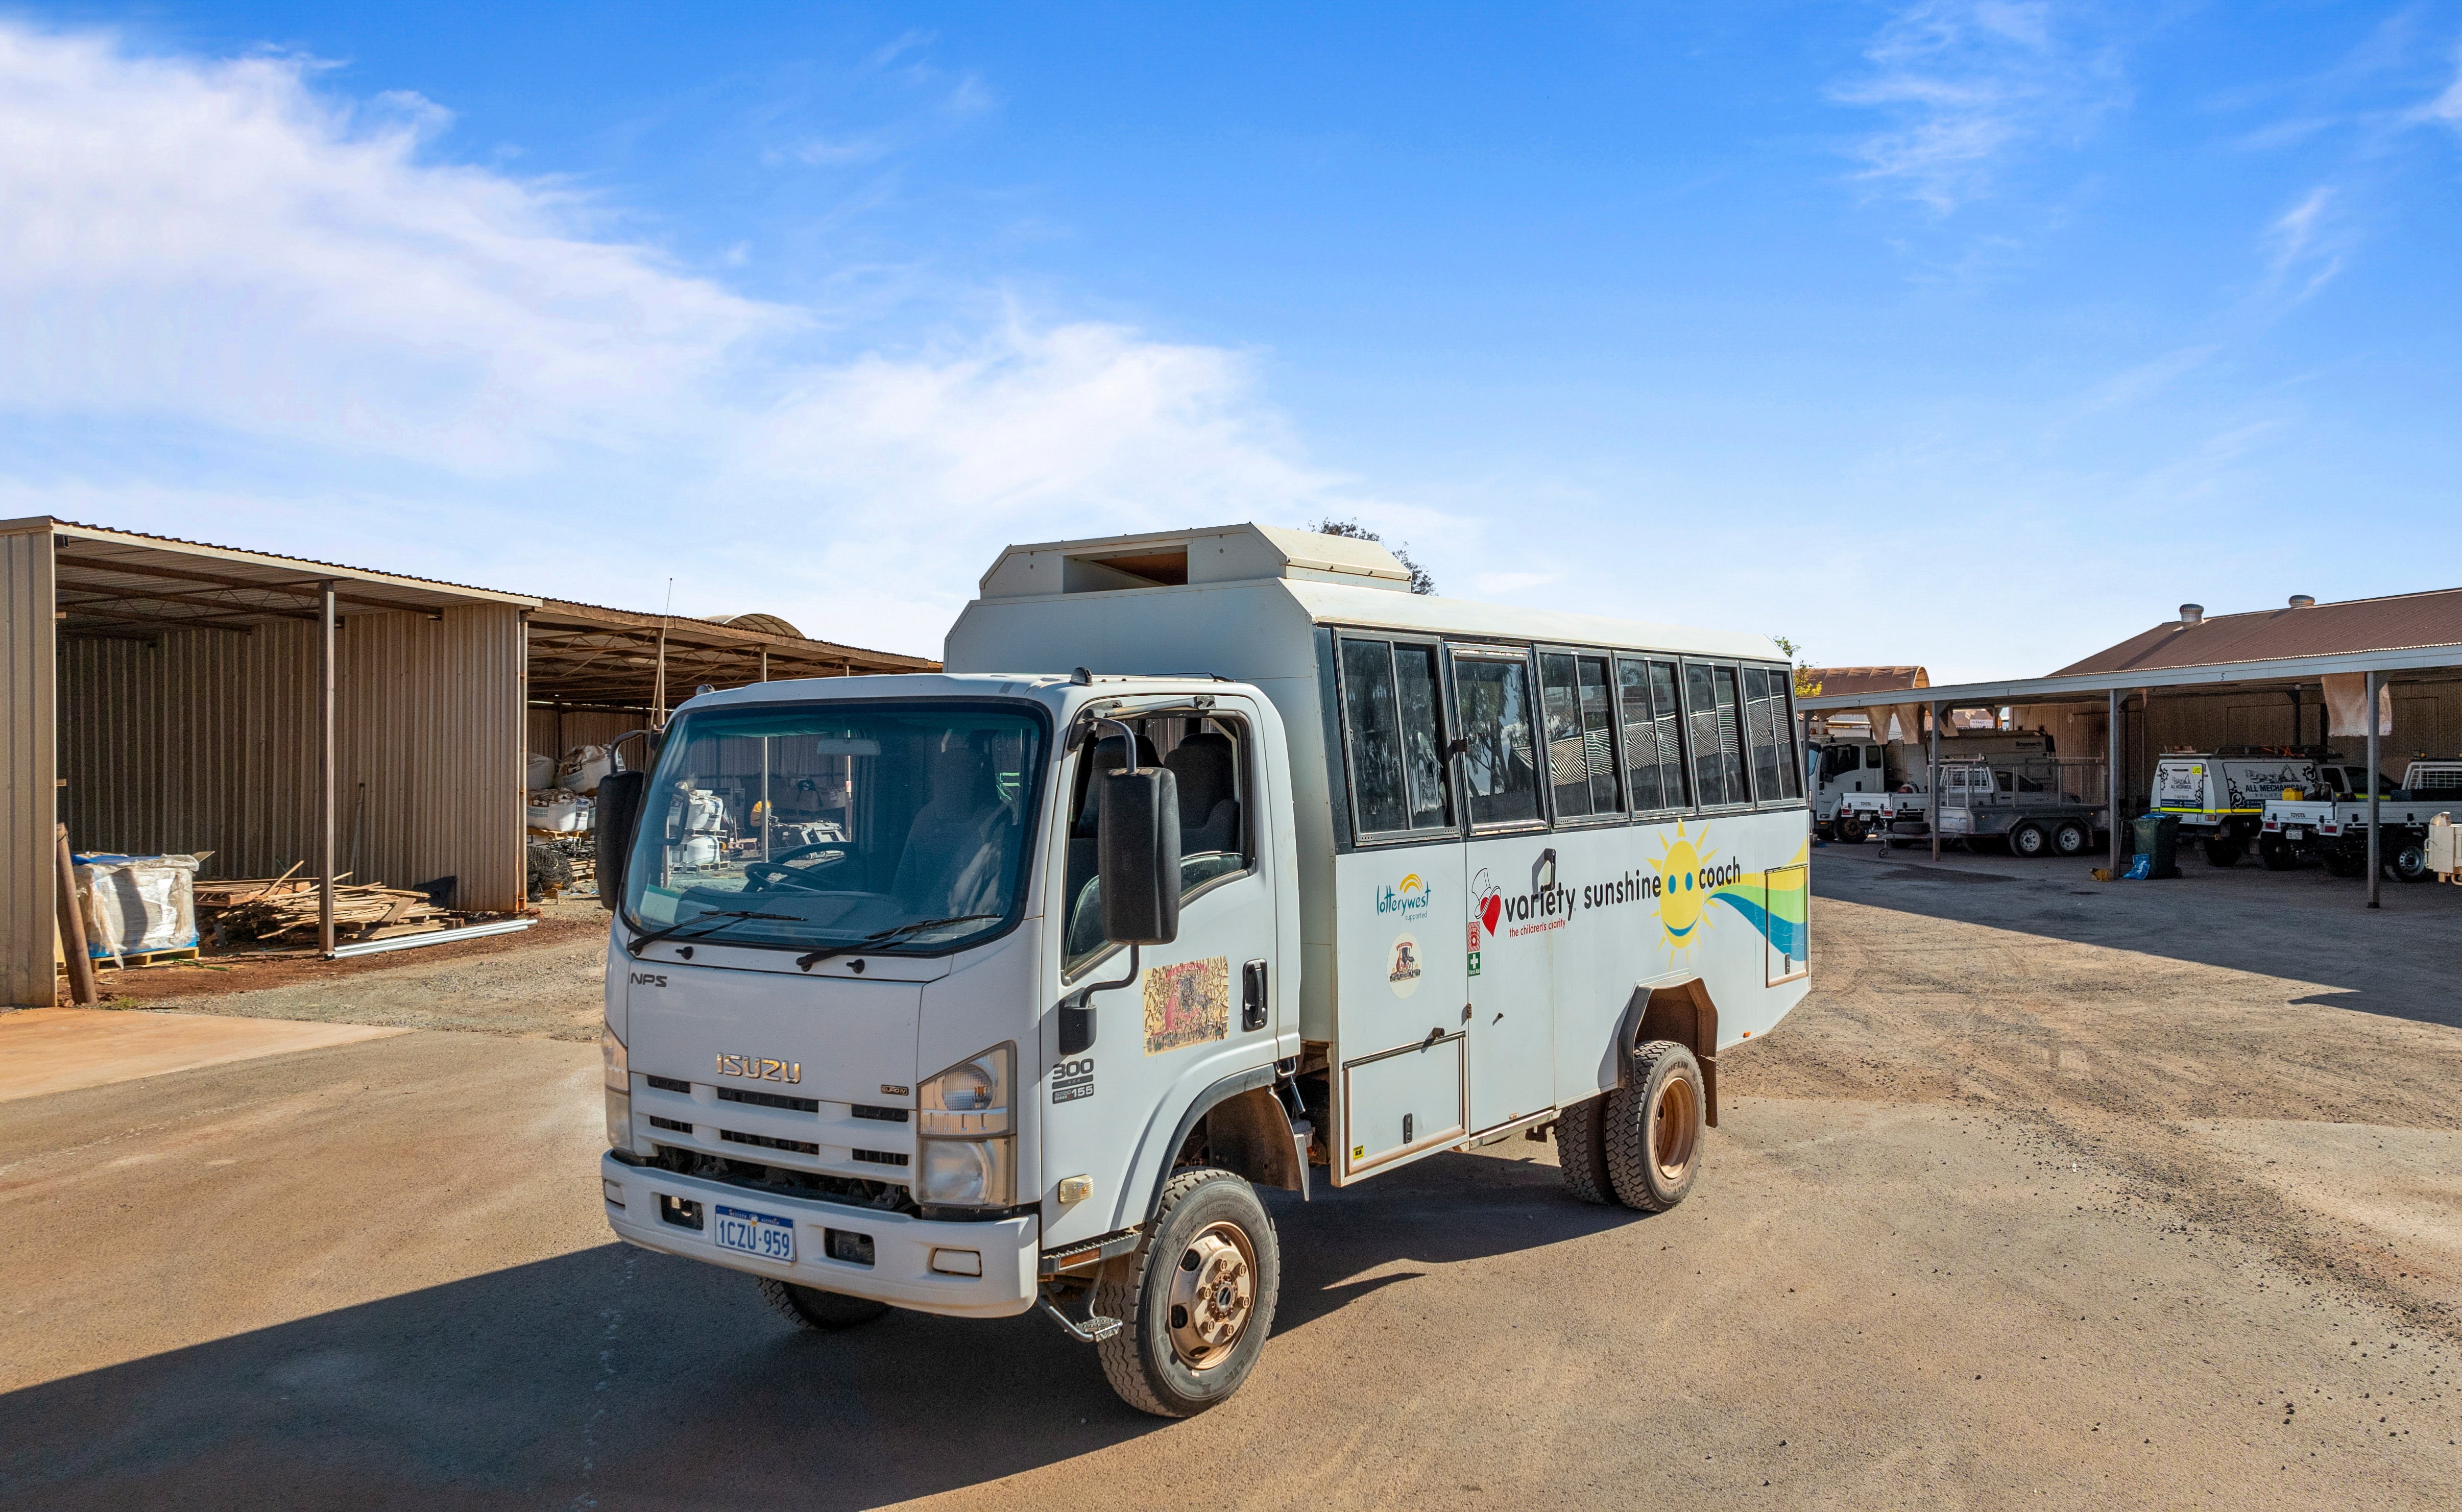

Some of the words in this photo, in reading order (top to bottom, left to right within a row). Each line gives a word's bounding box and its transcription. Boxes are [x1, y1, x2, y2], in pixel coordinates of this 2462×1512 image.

[2220, 673, 2225, 681] 5
[1505, 882, 1576, 922] variety
[1584, 869, 1661, 909] sunshine
[1699, 856, 1741, 889] coach
[1377, 881, 1432, 917] lotterywest
[1405, 910, 1428, 922] supported
[1509, 927, 1519, 938] the
[1520, 922, 1547, 935] children's
[630, 972, 667, 988] NPS
[716, 1052, 802, 1084] ISUZU
[1053, 1058, 1094, 1080] 300
[1656, 1061, 1688, 1094] MICHELIN
[1072, 1085, 1093, 1098] 155
